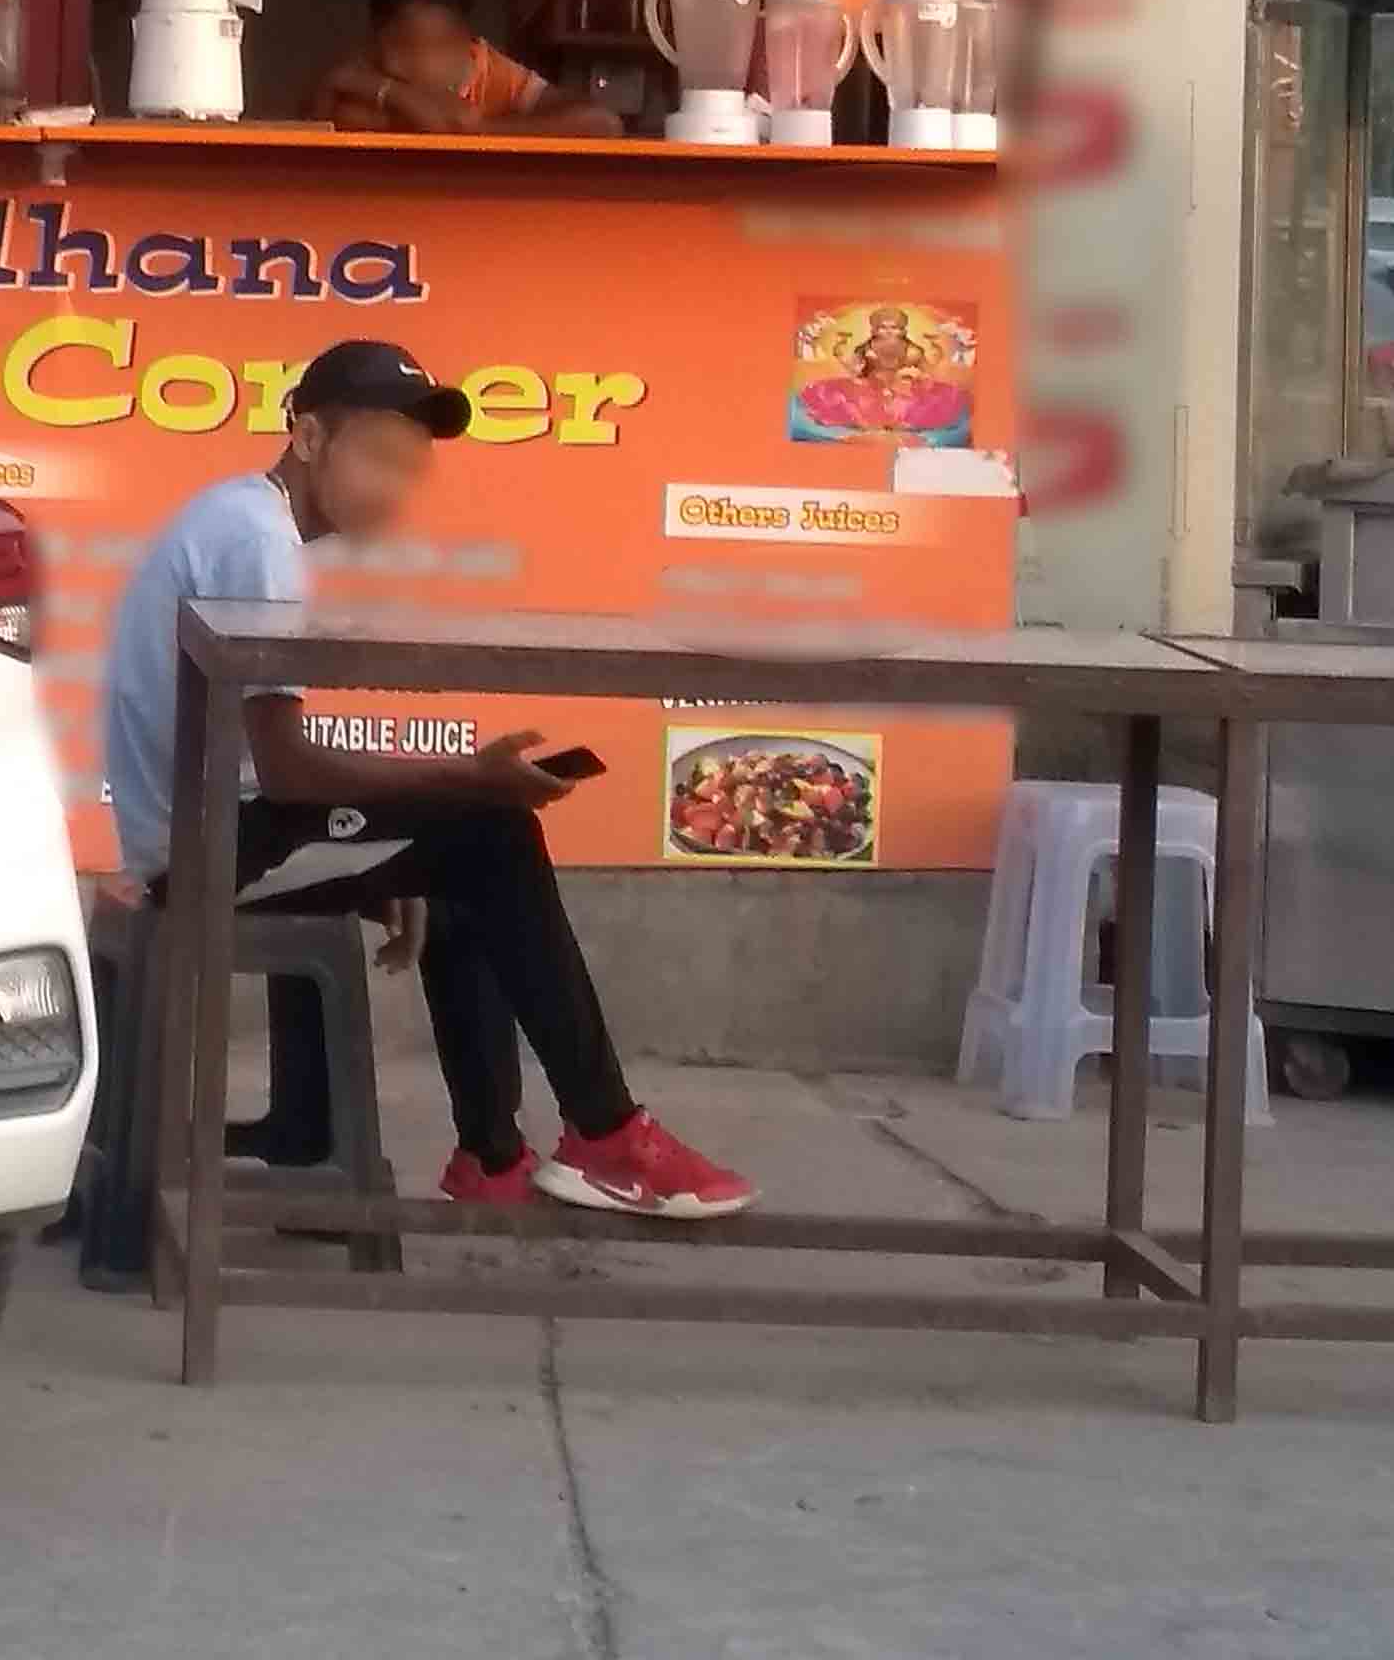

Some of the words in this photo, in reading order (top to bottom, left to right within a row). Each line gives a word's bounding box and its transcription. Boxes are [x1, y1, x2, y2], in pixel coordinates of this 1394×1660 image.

[4, 313, 648, 445] Corer
[679, 494, 789, 528] Others
[800, 500, 900, 533] Juices
[302, 715, 395, 753] ITABLE
[402, 718, 477, 756] JUICE
